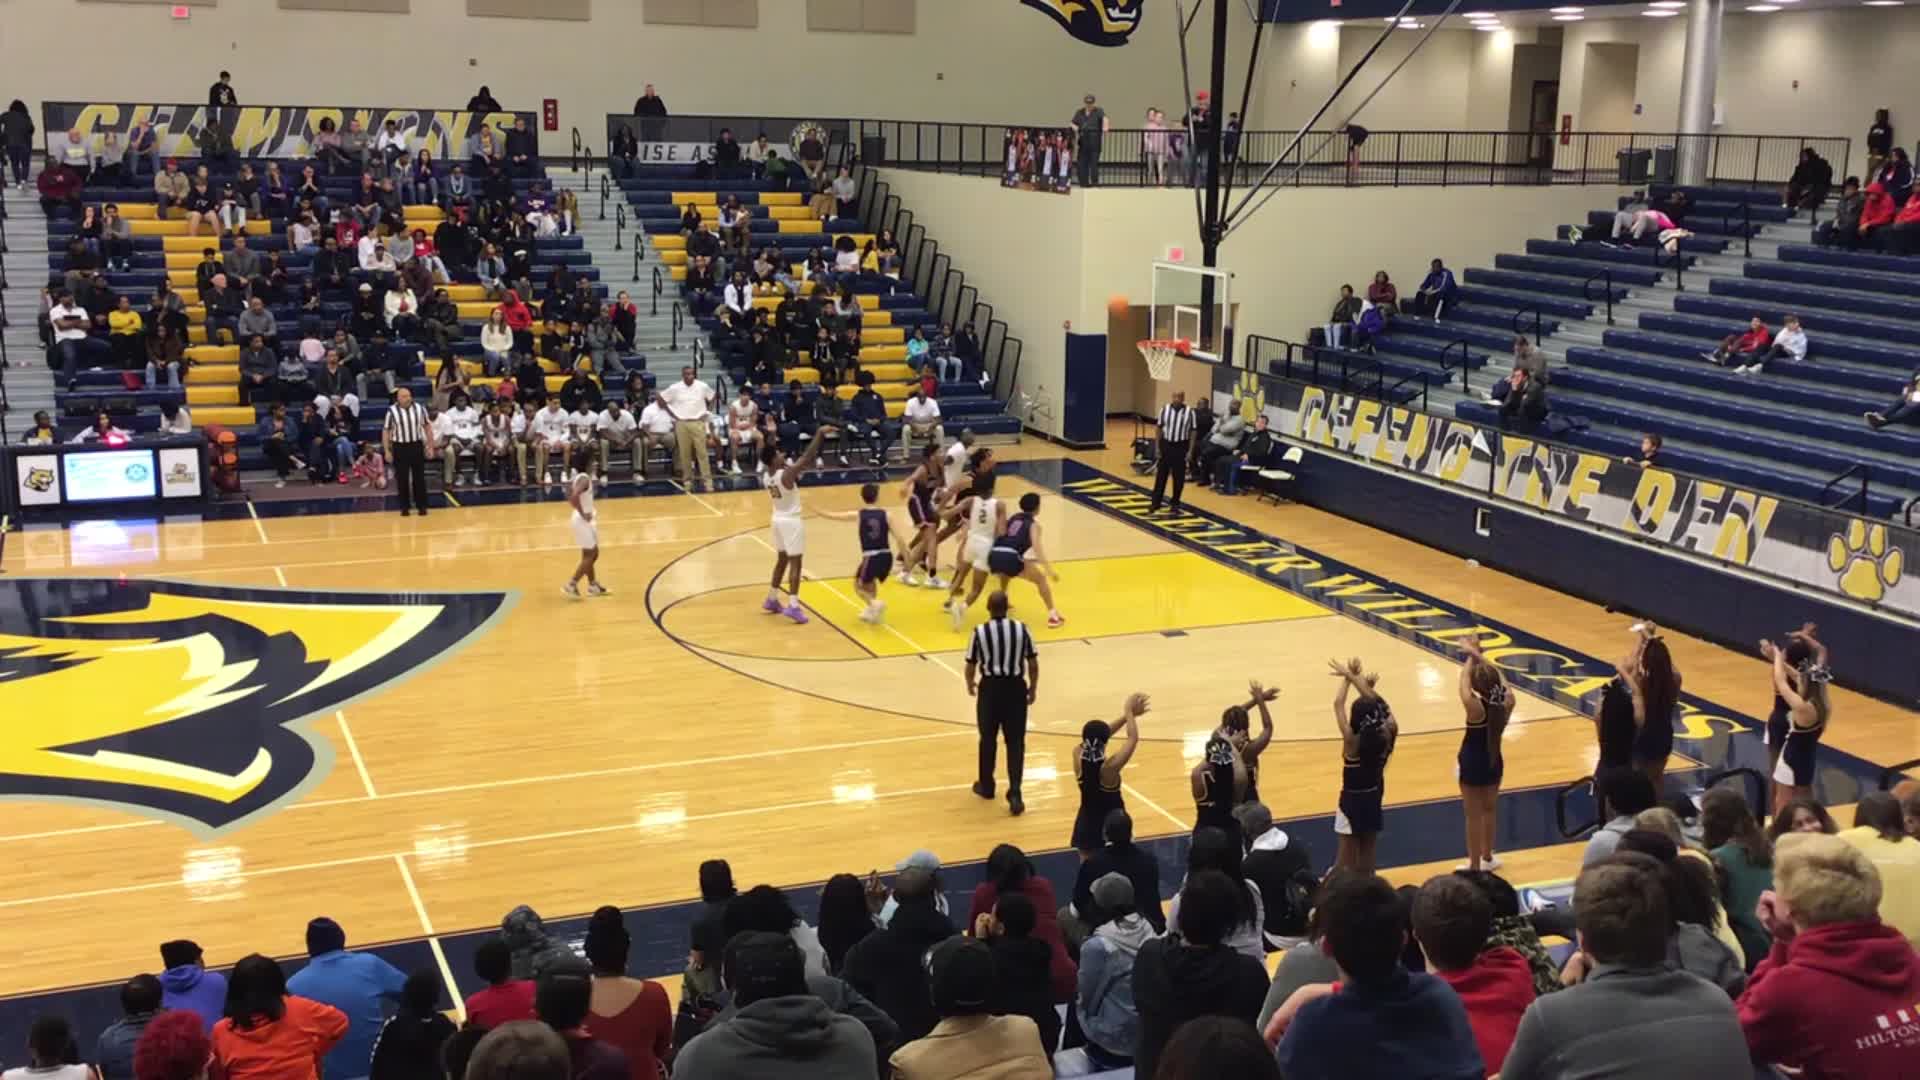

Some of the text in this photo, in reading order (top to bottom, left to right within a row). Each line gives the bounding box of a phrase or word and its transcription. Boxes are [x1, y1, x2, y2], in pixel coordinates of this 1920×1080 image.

[1295, 384, 1779, 566] DEFEND THE DEN
[1062, 477, 1753, 740] WHEELER WILDCAS
